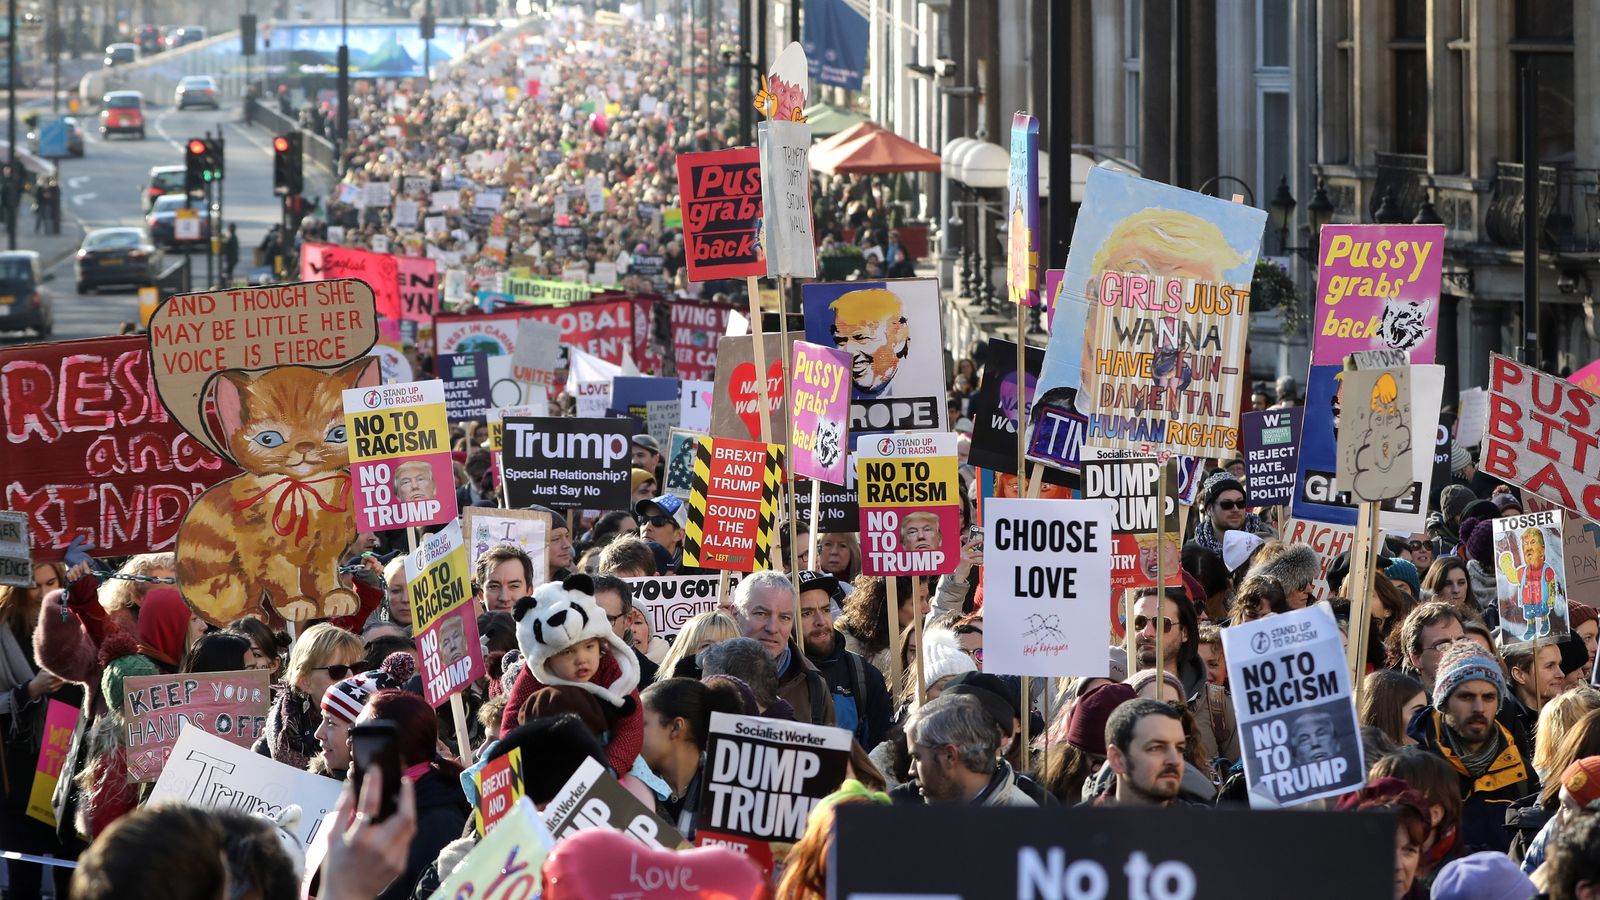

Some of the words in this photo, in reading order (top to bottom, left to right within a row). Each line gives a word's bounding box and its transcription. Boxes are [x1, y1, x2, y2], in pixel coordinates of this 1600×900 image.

[694, 234, 754, 260] back
[1324, 234, 1433, 283] Pussy
[168, 295, 216, 317] AND
[227, 286, 307, 311] THOUGH
[315, 281, 355, 306] SHE
[1100, 272, 1183, 314] GIRLS
[1185, 283, 1250, 316] JUST
[1324, 272, 1404, 306] grabs
[153, 321, 205, 347] MAY
[212, 319, 236, 341] BE
[245, 313, 309, 338] LITTLE
[321, 310, 363, 331] HER
[1113, 317, 1222, 351] WANNA
[1321, 309, 1382, 339] back
[163, 347, 227, 374] VOICE
[244, 343, 262, 367] IS
[274, 336, 346, 364] FIERCE
[1096, 348, 1155, 379] HAVE
[1175, 352, 1238, 383] FUN-
[578, 383, 609, 396] LOVE
[740, 377, 782, 394] NATY
[794, 352, 844, 403] Pussy
[383, 388, 407, 397] STAND
[408, 387, 419, 395] UP
[384, 397, 394, 406] TO
[395, 394, 424, 404] RACISM
[445, 399, 486, 408] RECLAIM
[691, 390, 698, 408] I
[794, 389, 828, 416] grabs
[1100, 382, 1231, 418] DAMENTAL
[354, 414, 385, 437] NO
[389, 410, 419, 432] TO
[446, 409, 487, 418] POLITICS
[355, 429, 438, 458] RACISM
[793, 421, 816, 452] back
[896, 439, 920, 447] STAND
[922, 438, 933, 446] UP
[1089, 413, 1166, 443] HUMAN
[1166, 420, 1239, 450] RIGHTS
[505, 423, 628, 469] Trump
[715, 447, 765, 464] BREXIT
[898, 447, 907, 455] TO
[908, 446, 937, 455] RACISM
[1097, 450, 1132, 459] Socialist
[1249, 447, 1295, 461] REJECT
[358, 463, 391, 487] NO
[505, 468, 547, 480] Special
[550, 469, 628, 483] Relationship?
[723, 464, 753, 477] AND
[866, 462, 896, 482] NO
[901, 462, 930, 482] TO
[1086, 462, 1160, 498] DUMP
[1249, 461, 1285, 474] HATE.
[360, 484, 391, 507] TO
[532, 485, 557, 495] Just
[560, 485, 581, 498] Say
[584, 486, 601, 496] No
[713, 477, 761, 493] TRUMP
[867, 481, 947, 503] RACISM
[6, 481, 207, 550] KIND
[363, 500, 441, 528] TRUMP
[708, 504, 757, 520] SOUND
[828, 508, 845, 519] No
[867, 511, 899, 532] NO
[1500, 511, 1554, 532] TOSSER
[717, 520, 745, 534] THE
[995, 517, 1098, 553] CHOOSE
[423, 538, 440, 554] STAND
[439, 533, 448, 544] UP
[430, 541, 452, 562] RACISM
[703, 534, 753, 550] ALARM
[867, 532, 897, 552] TO
[868, 551, 946, 572] TRUMP
[1571, 554, 1598, 576] PAY
[412, 576, 429, 606] NO
[428, 561, 451, 590] TO
[1014, 565, 1077, 599] LOVE
[416, 576, 465, 628] RACISM
[1271, 624, 1298, 639] STAND
[1298, 621, 1312, 632] UP
[1273, 638, 1283, 648] TO
[1284, 630, 1318, 646] RACISM
[420, 629, 438, 660] NO
[423, 654, 441, 681] TO
[427, 655, 473, 704] TRUMP
[1242, 660, 1277, 691] NO
[1280, 651, 1315, 680] TO
[128, 678, 198, 717] KEEP
[210, 681, 262, 702] YOUR
[1246, 670, 1339, 715] RACISM
[215, 712, 266, 738] OFF
[735, 722, 784, 741] Socialist
[785, 730, 827, 746] Worker
[1251, 719, 1288, 750] NO
[127, 750, 161, 781] HER
[712, 738, 821, 794] DUMP
[1255, 745, 1291, 774] TO
[482, 768, 511, 798] BREXIT
[1260, 756, 1348, 797] TRUMP
[488, 794, 506, 817] AND
[558, 781, 588, 815] Worker
[630, 852, 700, 891] Love
[1017, 846, 1108, 900] No
[1124, 851, 1196, 900] to
